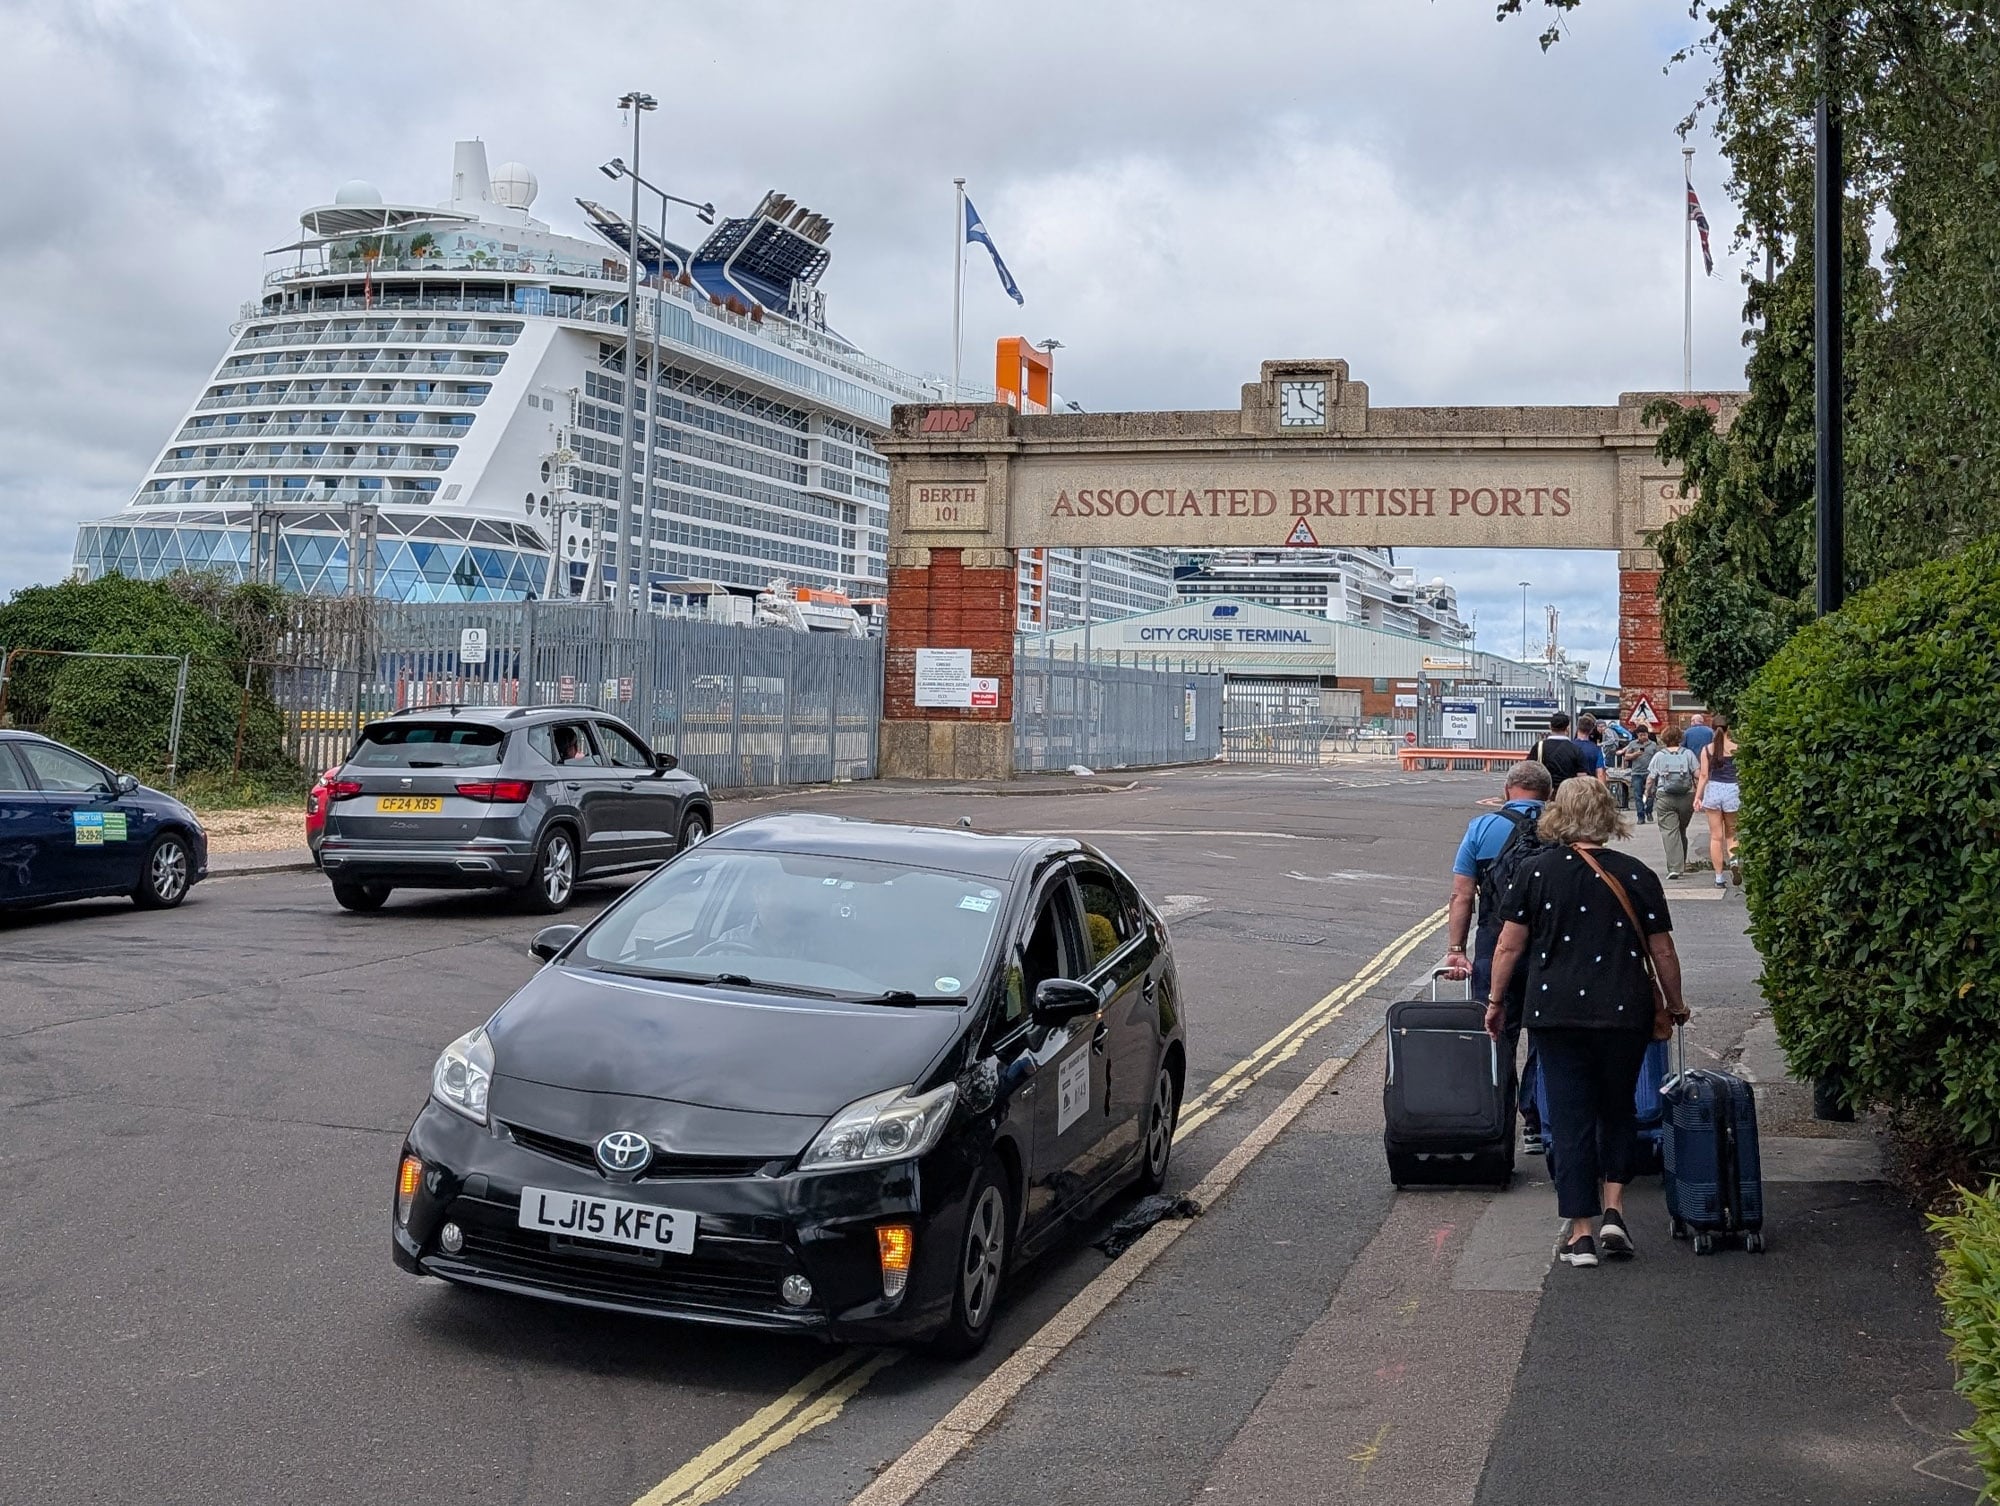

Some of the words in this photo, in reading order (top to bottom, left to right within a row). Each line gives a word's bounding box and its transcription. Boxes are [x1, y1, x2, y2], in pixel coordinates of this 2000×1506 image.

[921, 409, 976, 432] ABP
[919, 488, 976, 502] BERTH
[1051, 489, 1277, 517] ASSOCIATED
[1289, 488, 1436, 517] BRITISH
[1448, 488, 1571, 517] PORTS
[935, 507, 959, 521] 101
[1212, 605, 1240, 617] ABP
[1140, 628, 1174, 641] CITY
[1177, 628, 1232, 642] CRUISE
[1236, 629, 1312, 643] TERMINAL
[382, 798, 411, 810] CF24
[414, 798, 437, 810] XBS
[538, 1194, 606, 1233] LJ15
[613, 1206, 675, 1244] KFG
